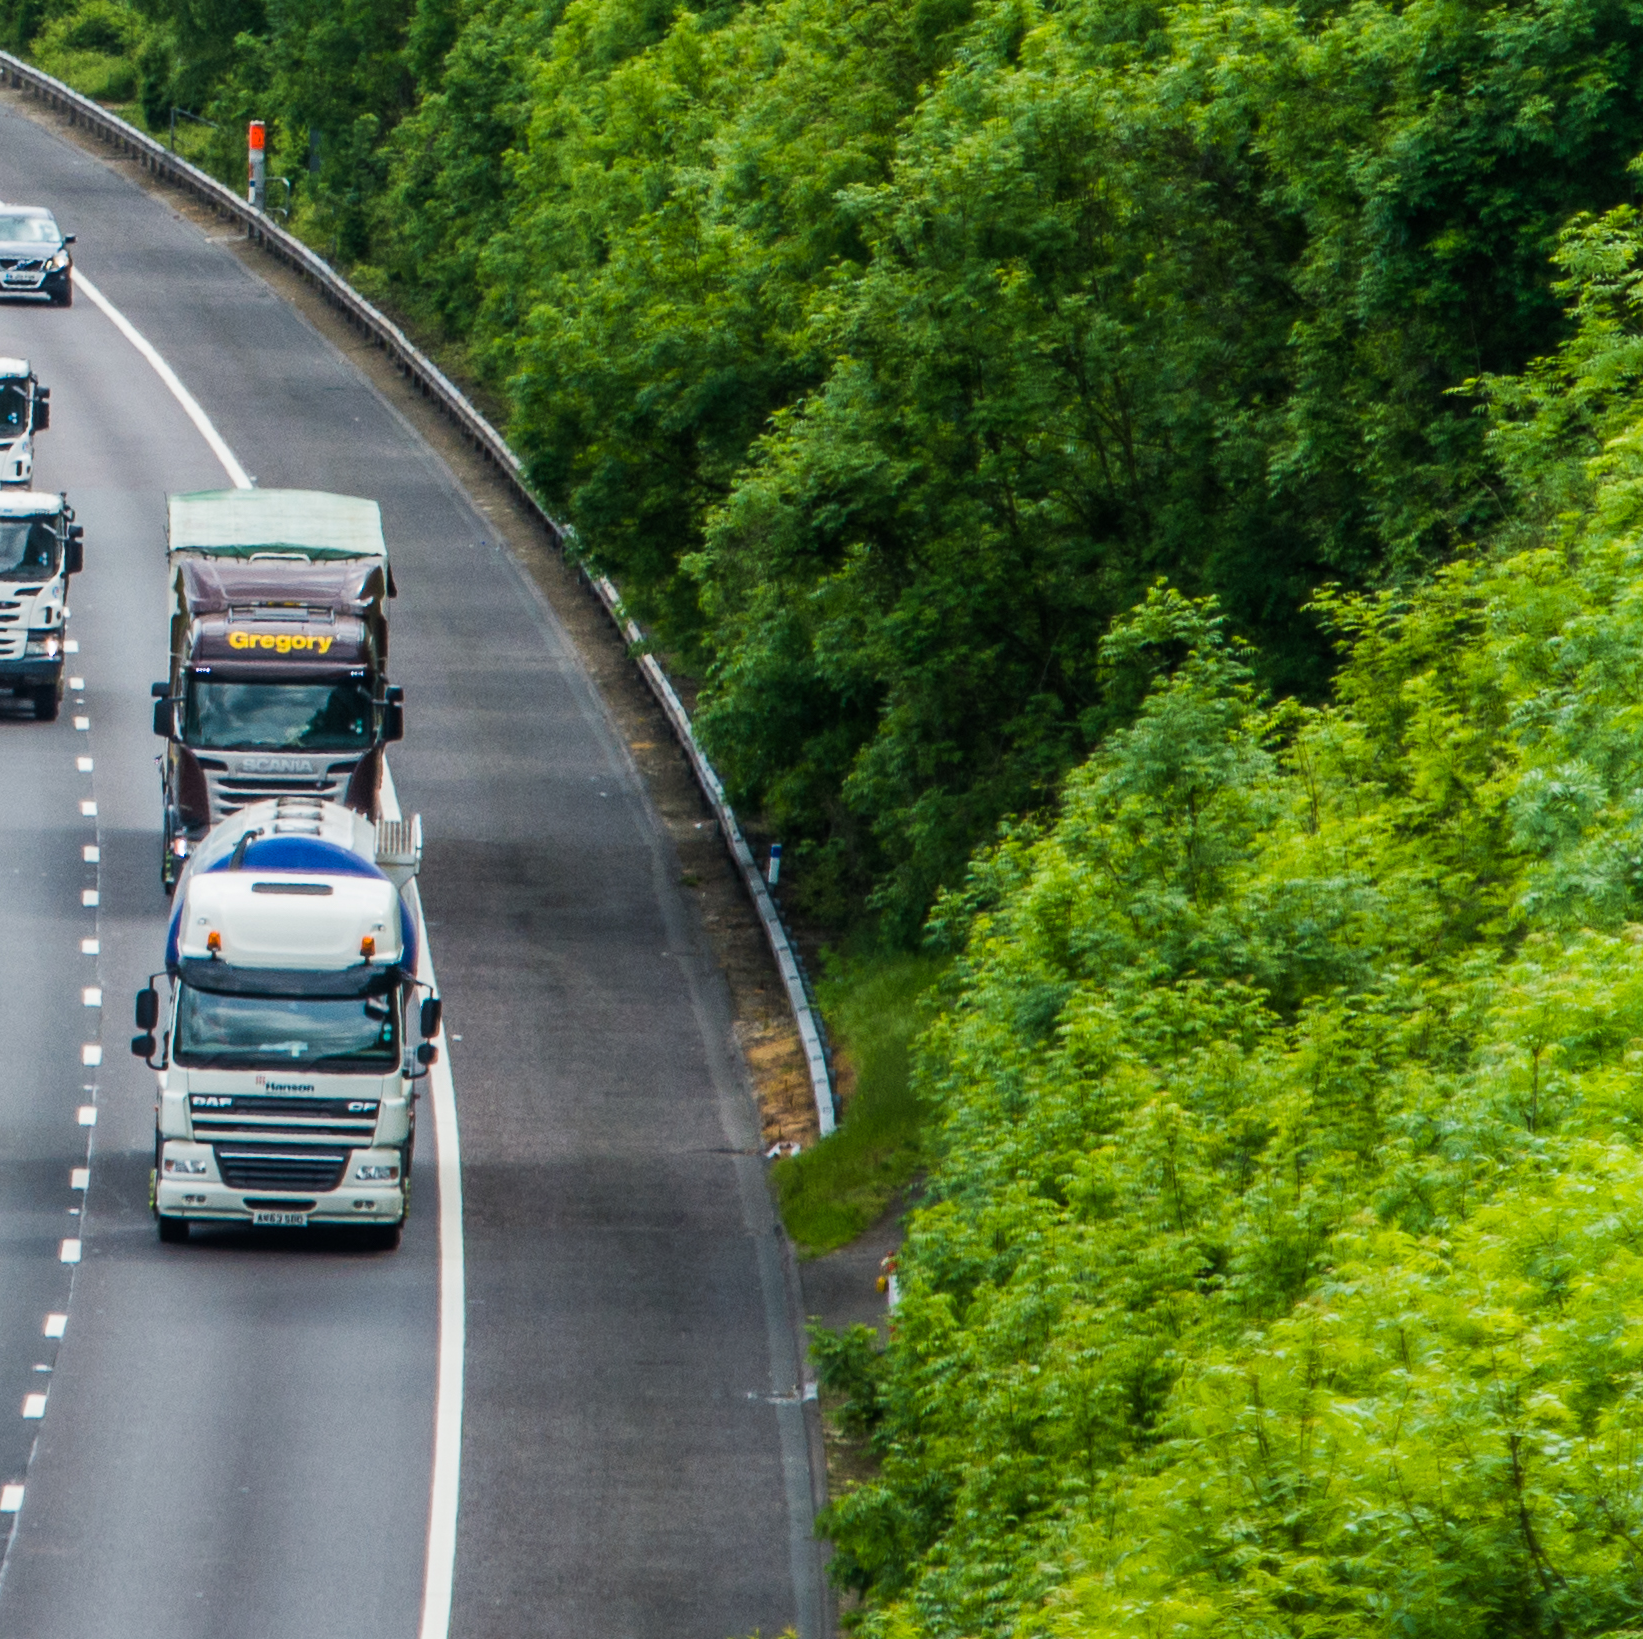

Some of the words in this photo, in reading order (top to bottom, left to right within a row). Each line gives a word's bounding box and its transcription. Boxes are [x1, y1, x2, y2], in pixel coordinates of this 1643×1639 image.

[228, 631, 333, 654] Gregory
[242, 758, 313, 773] SCANIA
[265, 1081, 315, 1093] Hanson
[192, 1095, 233, 1108] DAF
